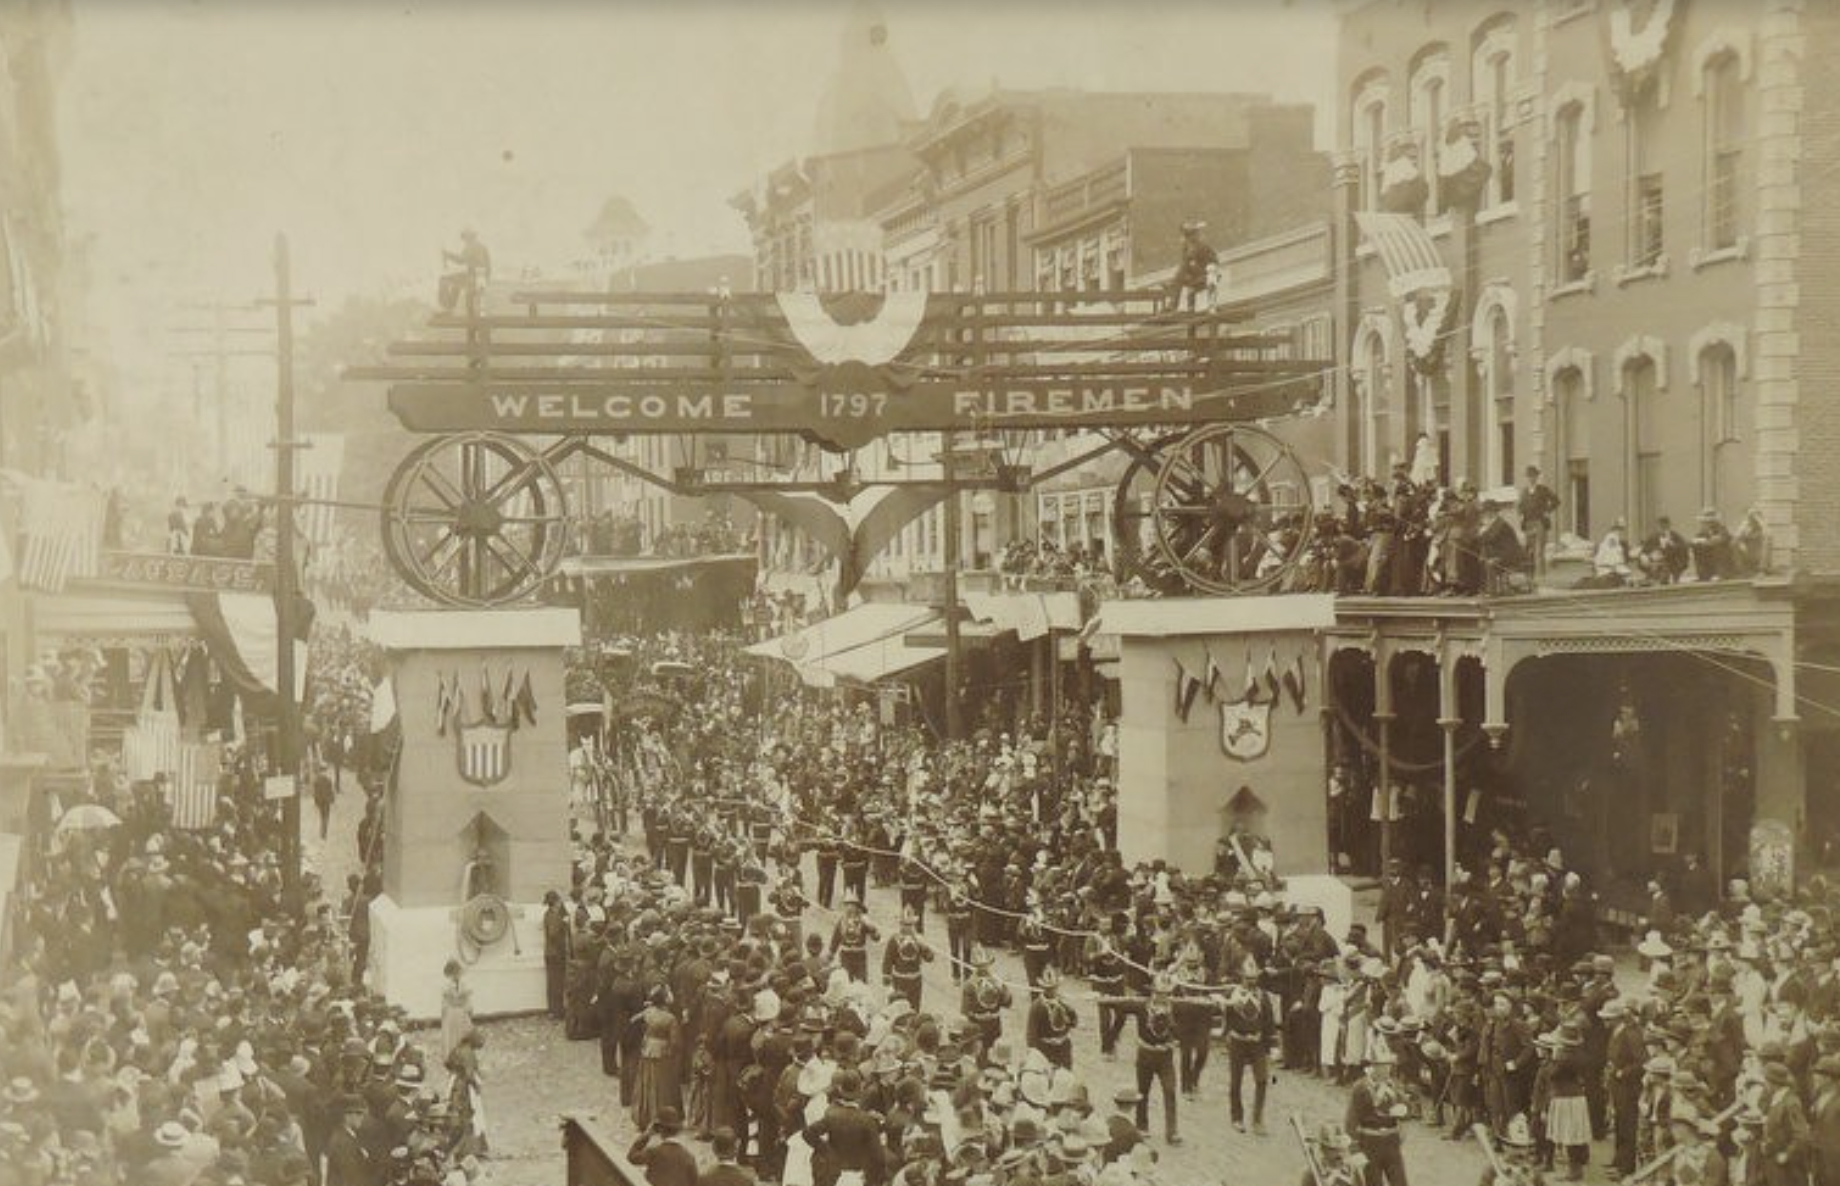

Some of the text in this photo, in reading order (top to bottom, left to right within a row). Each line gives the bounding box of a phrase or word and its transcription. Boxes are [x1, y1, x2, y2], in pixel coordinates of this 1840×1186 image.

[491, 388, 1193, 419] WELCOME 1797 FIREMEN
